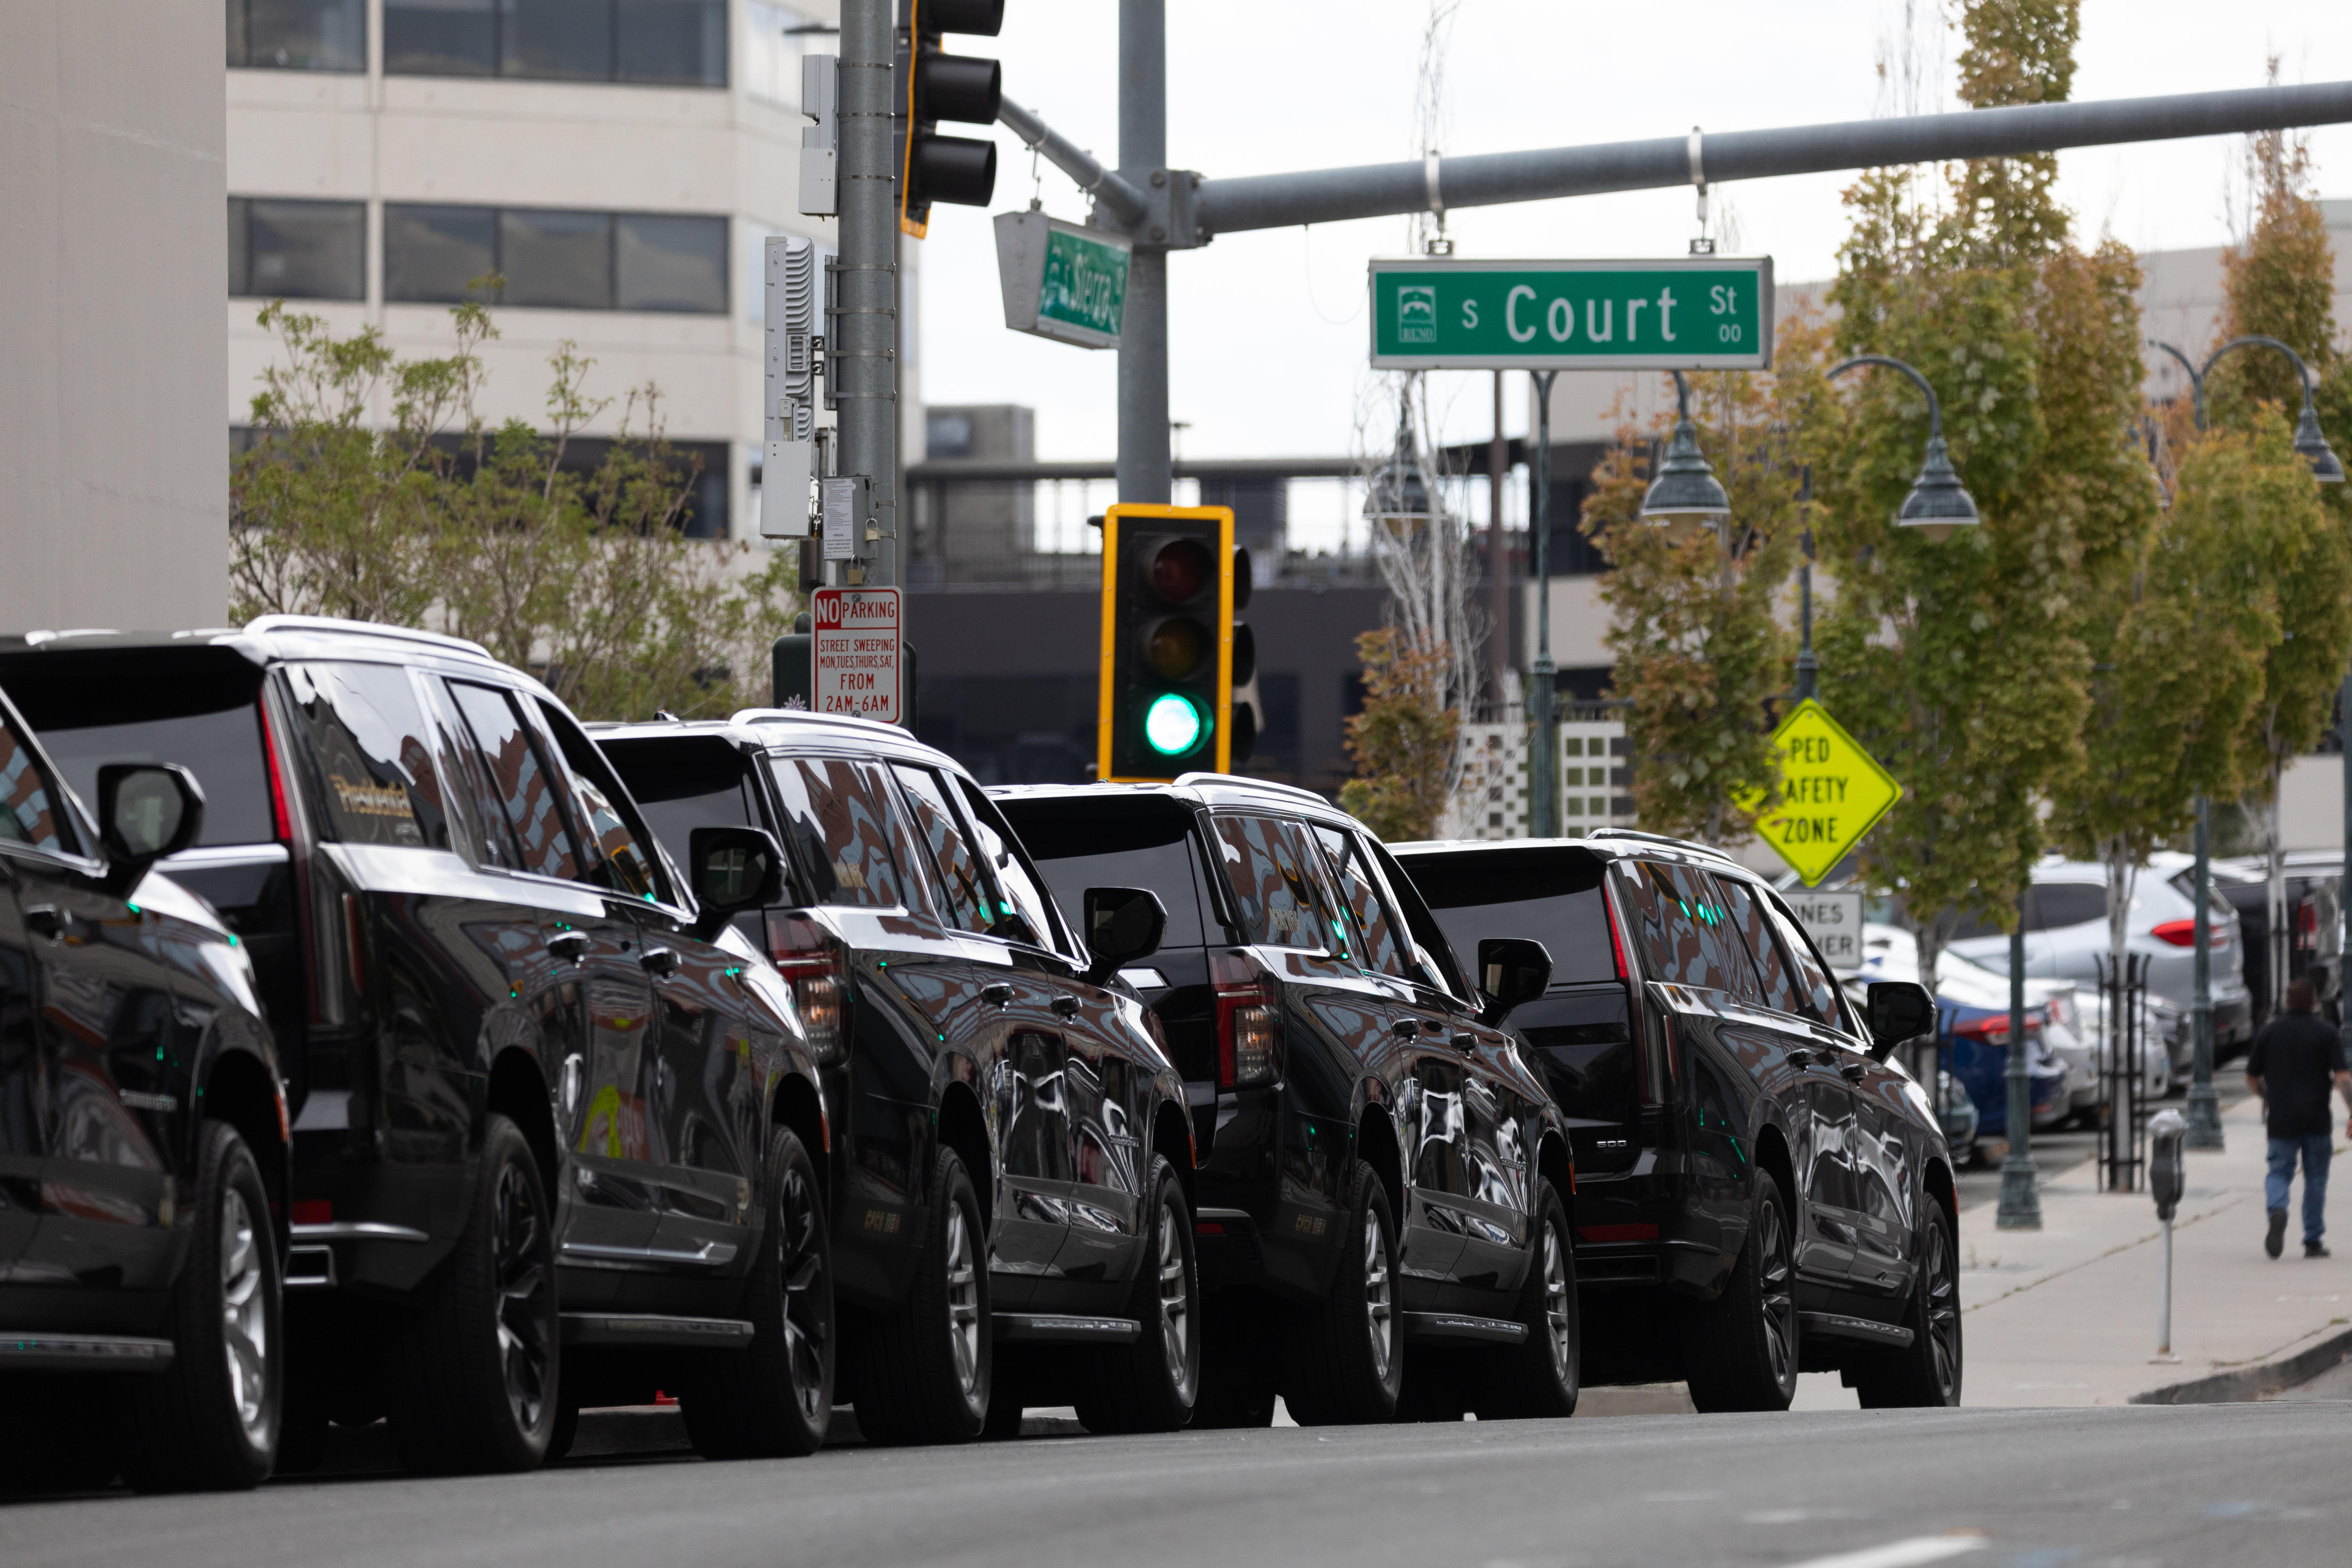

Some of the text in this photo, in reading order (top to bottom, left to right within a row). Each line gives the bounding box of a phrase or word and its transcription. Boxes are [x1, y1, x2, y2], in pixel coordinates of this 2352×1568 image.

[1462, 284, 1738, 343] S Court St
[1719, 324, 1742, 343] 00
[817, 598, 895, 623] NO PARKING
[820, 638, 895, 652] STREET SWEEPING
[840, 673, 874, 690] FROM
[826, 695, 889, 712] 2AM-6AM
[1790, 736, 1830, 764] PED
[1786, 776, 1849, 804] AFETY
[1784, 817, 1838, 844] ZONE
[1790, 903, 1843, 924] INES
[1597, 1140, 1627, 1148] 600
